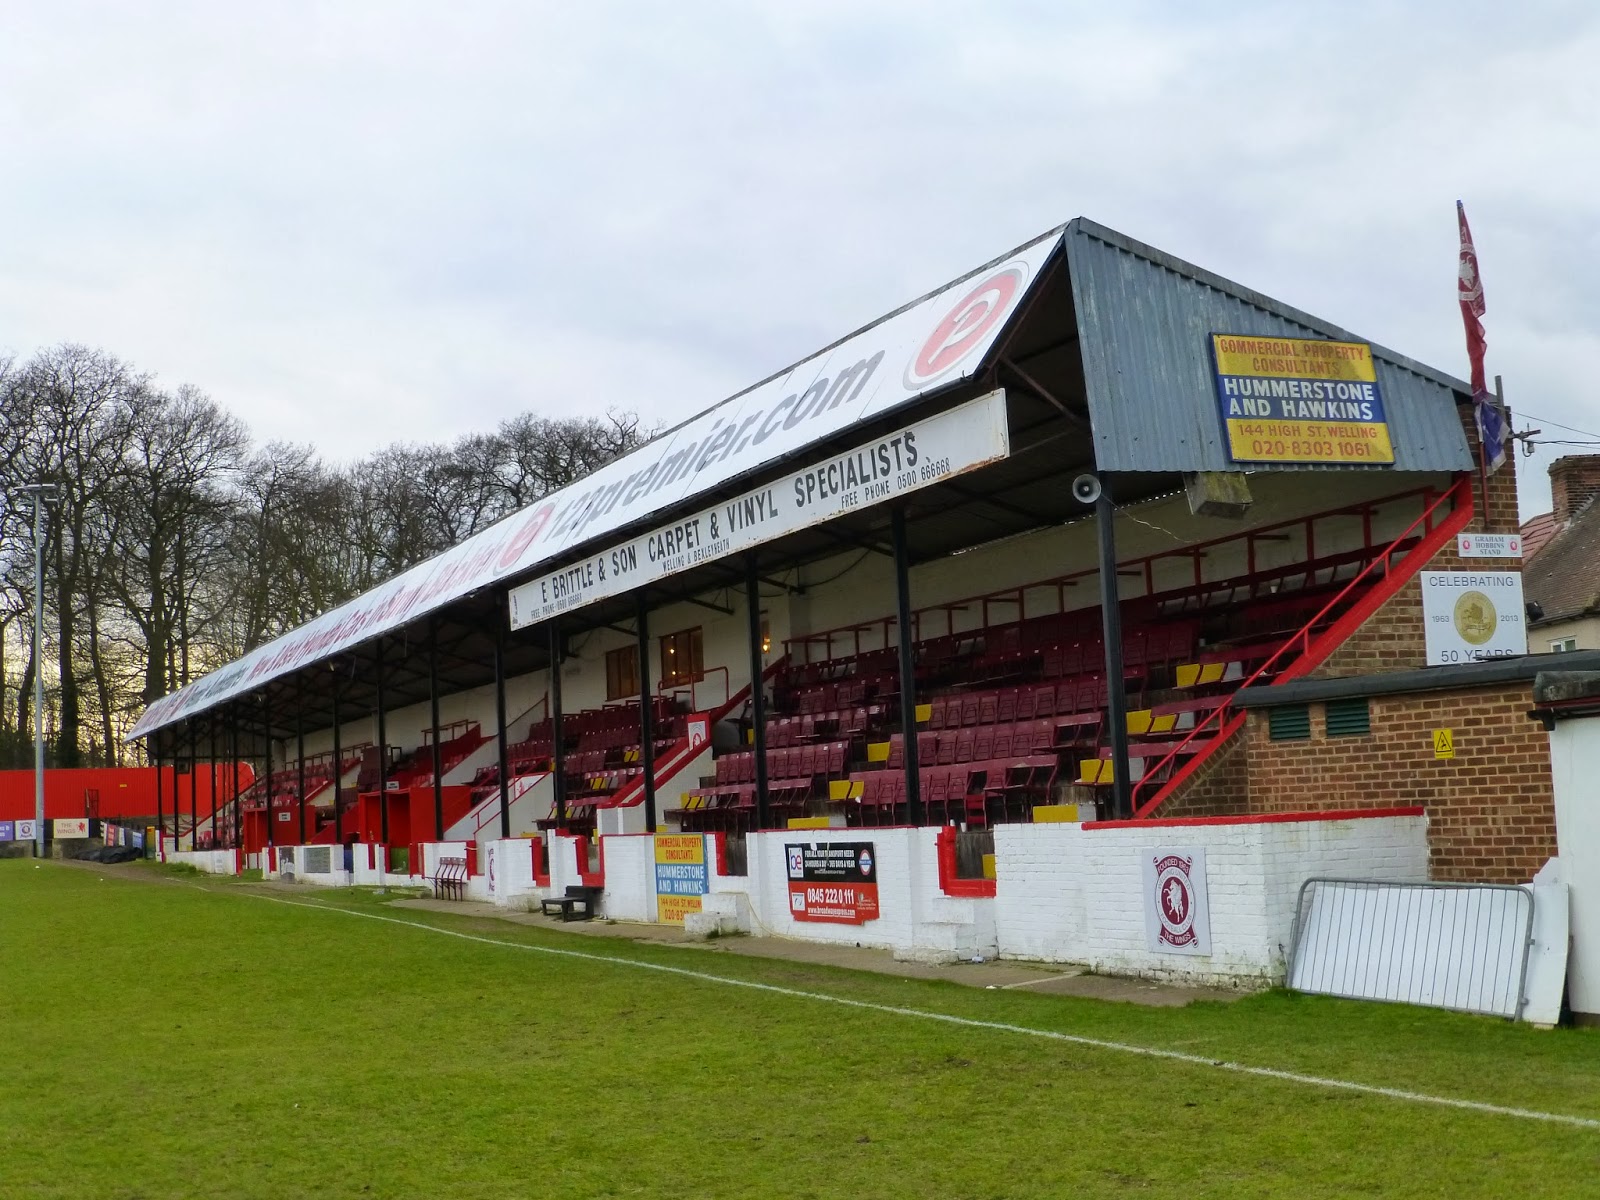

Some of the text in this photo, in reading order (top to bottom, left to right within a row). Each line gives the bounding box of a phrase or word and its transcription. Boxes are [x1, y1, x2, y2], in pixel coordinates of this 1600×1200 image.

[1220, 338, 1364, 361] COMMERCIAL PROPERTY
[1253, 357, 1341, 374] CONSULTANTS
[1224, 378, 1375, 401] HUMMERSTONE
[1229, 398, 1373, 420] AND HAWKINS
[1239, 424, 1264, 436] 144
[1268, 425, 1300, 437] HIGH
[1327, 426, 1377, 438] WELLING
[1252, 440, 1371, 456] 020-8303 1061
[841, 457, 950, 509] FREE PHONE 0500 666668
[541, 435, 918, 603] E BRITTLE & SON CARPET & VINYL SPECIALISTS
[662, 555, 685, 572] WELLING
[687, 553, 691, 564] &
[1429, 576, 1514, 587] CELEBRATING
[1431, 615, 1449, 623] 1963
[1441, 650, 1459, 662] 50
[681, 838, 702, 848] PROPERTY
[657, 865, 704, 879] HUMMERSTONE
[1158, 858, 1178, 873] FOUNDED
[659, 880, 703, 894] AND HAWKINS
[807, 888, 854, 904] 0845 222 0 111
[687, 899, 702, 909] WELLIN
[1164, 930, 1191, 944] THE WINGS
